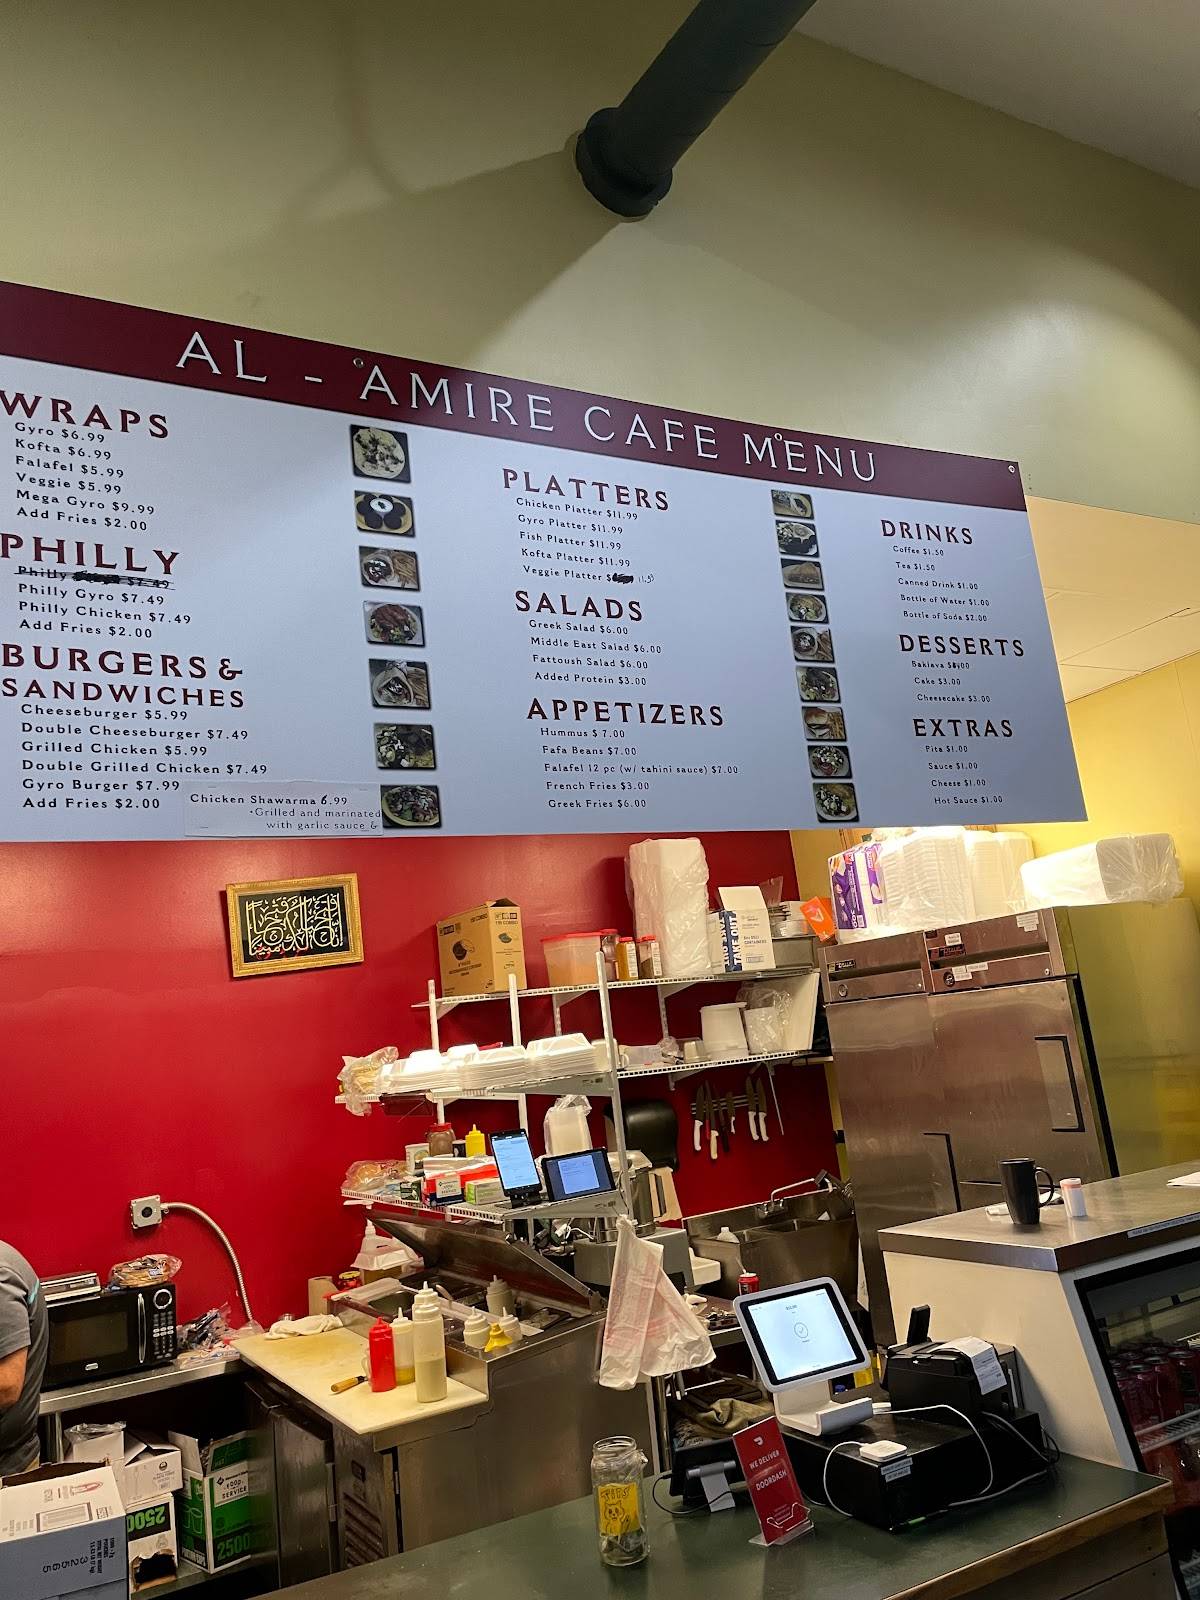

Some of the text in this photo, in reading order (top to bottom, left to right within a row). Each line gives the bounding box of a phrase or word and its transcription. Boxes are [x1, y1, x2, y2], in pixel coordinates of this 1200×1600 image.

[176, 331, 267, 382] AL
[360, 365, 554, 432] AMIRE
[583, 405, 718, 459] CAFE
[743, 433, 876, 481] MENU
[0, 390, 168, 440] WRAPS
[15, 422, 104, 443] Gyro $6.99
[15, 438, 111, 460] Kofta $6.99
[16, 455, 124, 478] Falafel $5.99
[16, 472, 121, 494] Veggie $5.99
[502, 468, 668, 513] PLATTERS
[16, 489, 154, 515] Mega Gyro $9.99
[516, 497, 638, 520] Chicken Platter $11.99
[17, 507, 147, 531] Add Fries $2.00
[518, 514, 623, 534] Gyro Platter $11.99
[520, 531, 621, 550] Fish Platter $11.99
[881, 520, 972, 545] DRINKS
[0, 533, 180, 575] PHILLY
[521, 548, 630, 567] Kofta Platter $11.99
[893, 545, 944, 556] Coffee $1.50
[523, 565, 559, 577] Veggie
[564, 569, 602, 581] Platter
[895, 561, 935, 571] Tea $1.50
[898, 577, 978, 590] Canned Drink $1.00
[19, 583, 164, 605] Philly Gyro $7.49
[900, 594, 926, 603] Bottle
[940, 596, 966, 605] Water
[968, 598, 989, 607] $1.00
[19, 601, 191, 624] Philly Chicken $7.49
[515, 590, 642, 622] SALADS
[903, 610, 929, 619] Bottle
[965, 614, 987, 622] $2.00
[19, 619, 152, 638] Add Fries $2.00
[529, 619, 628, 635] Greek Salad $6.00
[531, 637, 661, 654] Middle East Salad $6.00
[899, 634, 1024, 657] DESSERTS
[1, 643, 243, 680] BURGERS &
[532, 654, 648, 669] Fattoush Salad $6.00
[535, 672, 646, 686] Added Protein $3.00
[914, 677, 935, 685] Cake
[1, 678, 243, 708] SANDWICHES
[21, 704, 187, 720] Cheeseburger $5.99
[527, 698, 723, 726] APPETIZERS
[22, 722, 248, 740] Double Cheeseburger $7.49
[540, 727, 588, 737] Hummus
[913, 718, 1013, 738] EXTRAS
[22, 741, 207, 756] Grilled Chicken $5.99
[542, 745, 636, 756] Fafa Beans $7.00
[925, 745, 968, 753] Pita $1.00
[22, 759, 267, 775] Double Grilled Chicken $7.49
[544, 763, 738, 775] Falafel 12 pc (w/ tahini sauce) $7.00
[928, 762, 978, 770] Sauce $1.00
[22, 778, 179, 792] Gyro Burger $7.99
[546, 781, 649, 791] French Fries $3.00
[931, 779, 986, 787] Cheese $1.00
[22, 797, 160, 809] Add Fries $2.00
[190, 793, 347, 805] Chicken Shawarma 6.99
[548, 799, 646, 808] Greek Fries $6.00
[953, 796, 978, 804] Sauce
[981, 795, 1003, 804] $1.00
[300, 808, 320, 817] and
[325, 810, 381, 818] marinated
[266, 820, 292, 829] with
[297, 820, 330, 831] garlic
[370, 821, 379, 830] &
[749, 1461, 759, 1470] WE
[755, 1469, 788, 1491] DOORDASH
[222, 1485, 247, 1499] SERVICE
